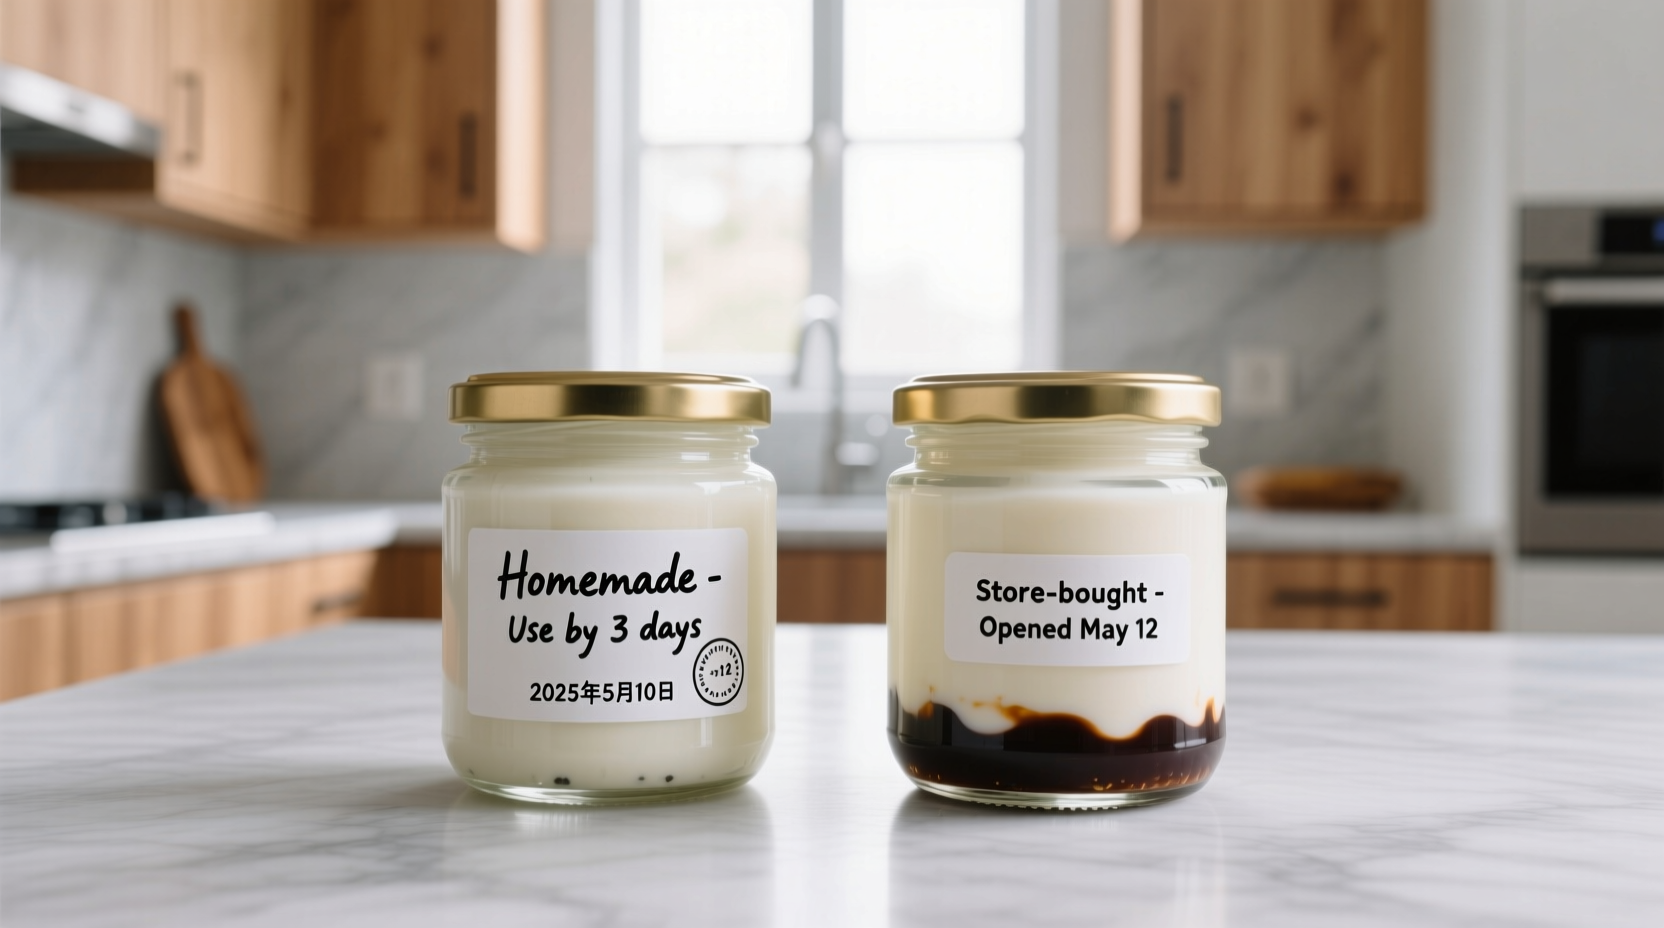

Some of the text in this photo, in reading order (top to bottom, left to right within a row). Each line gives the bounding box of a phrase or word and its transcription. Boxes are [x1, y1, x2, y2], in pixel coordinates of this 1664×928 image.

[496, 548, 698, 601] Homemade
[975, 578, 1148, 611] Store-bought
[508, 609, 702, 660] Use by 3 days
[979, 615, 1158, 647] Opened May 12
[529, 679, 674, 706] 2025年5月10日
